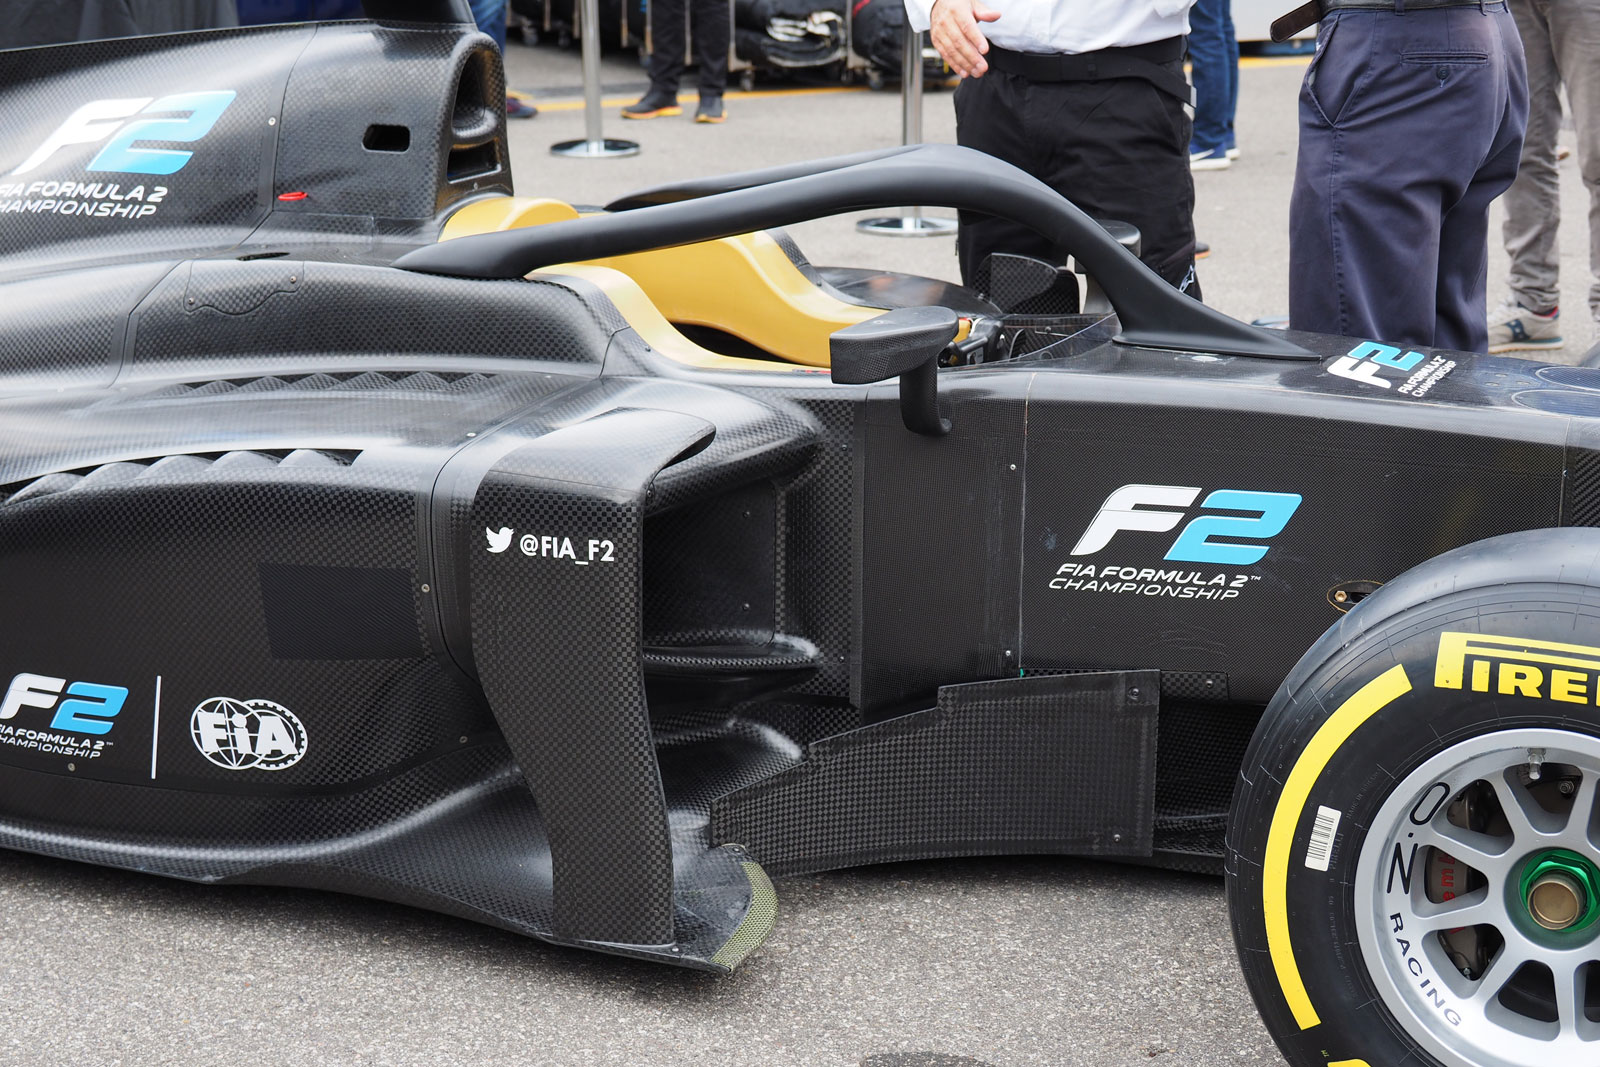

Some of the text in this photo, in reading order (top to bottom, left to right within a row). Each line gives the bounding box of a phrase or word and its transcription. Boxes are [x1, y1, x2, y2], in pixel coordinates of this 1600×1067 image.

[11, 90, 237, 175] F2
[25, 181, 145, 201] FORMULA
[147, 186, 168, 202] 2
[0, 199, 157, 219] HAMPIONSHIP
[1327, 341, 1424, 389] F2
[1070, 483, 1303, 566] F2
[520, 534, 615, 565] @FIA_F2
[1049, 578, 1240, 601] CHAMPIONSHIP
[1056, 563, 1096, 577] FIA
[1100, 566, 1226, 587] FORMULA
[1434, 631, 1600, 707] PIRE
[0, 672, 129, 735] F2
[0, 724, 14, 736] IA
[15, 728, 92, 749] FORMULA
[0, 734, 101, 759] HAMPIONSHIP
[1389, 911, 1462, 1029] RACING
